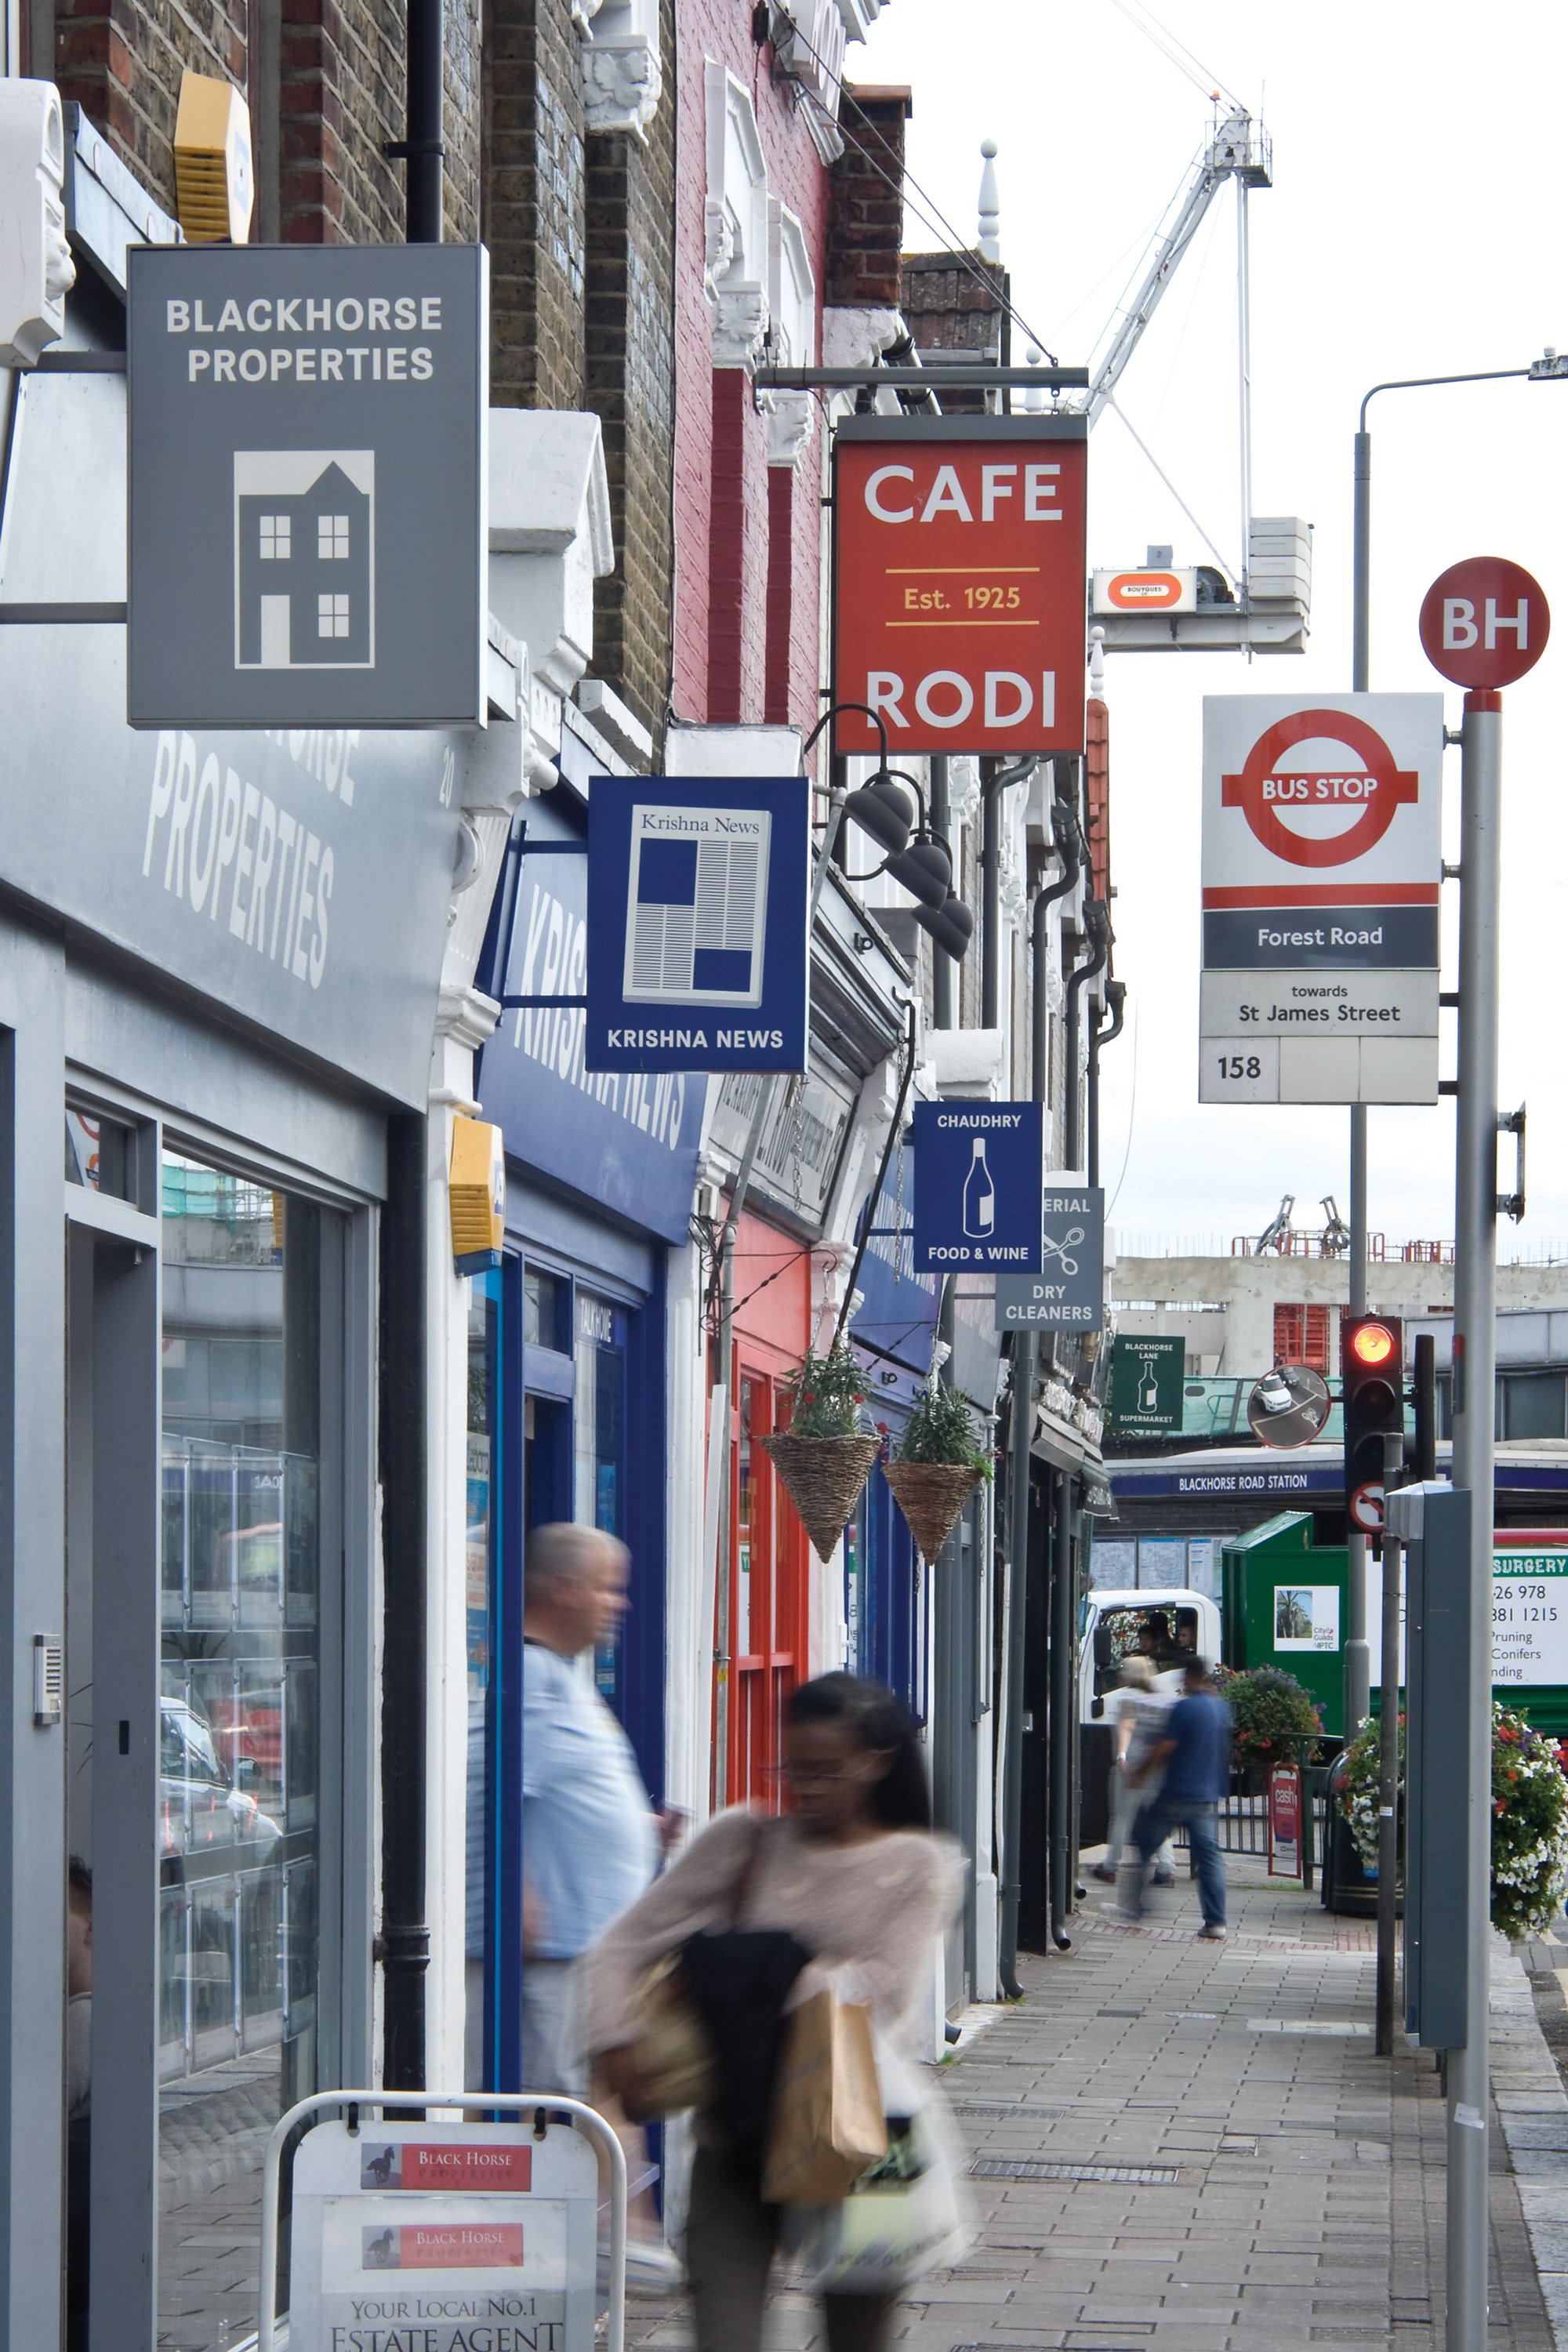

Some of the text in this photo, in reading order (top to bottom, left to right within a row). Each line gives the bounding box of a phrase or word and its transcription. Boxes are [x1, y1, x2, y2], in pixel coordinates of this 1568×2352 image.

[166, 297, 442, 332] BLACKHORSE
[188, 347, 434, 382] PROPERTIES
[864, 463, 1063, 524] CAFE
[904, 586, 1021, 610] Est. 1925
[1443, 597, 1528, 651] BH
[866, 670, 1056, 729] RODI
[1262, 778, 1378, 800] BUS STOP
[641, 814, 760, 834] Krishna News
[143, 730, 334, 989] PROPERTIES
[1258, 926, 1383, 947] Forest Road
[1291, 985, 1348, 998] towards
[1239, 1004, 1400, 1022] St James Street
[608, 1029, 784, 1049] KRISHNA NEWS
[1218, 1056, 1261, 1080] 158
[937, 1115, 1022, 1128] CHAUDHRY
[1044, 1199, 1091, 1213] ERIAL
[927, 1247, 1029, 1260] FOOD & WINE
[1033, 1285, 1066, 1299] DRY
[1005, 1305, 1093, 1320] CLEANERS
[1124, 1343, 1174, 1352] BLACKHORSE
[1119, 1414, 1174, 1424] SUPERMARKET
[1179, 1474, 1308, 1491] BLACKHORSE ROAD STATION
[1493, 1559, 1566, 1573] SURGERY
[1493, 1585, 1545, 1599] 26 978
[1524, 1607, 1558, 1621] 1215
[1492, 1647, 1541, 1660] Conifers
[1491, 1666, 1523, 1679] nding
[1276, 1786, 1294, 1804] cash
[419, 2151, 512, 2166] BLACK HORSE
[416, 2230, 504, 2245] BLACK HORSE
[350, 2300, 410, 2320] YOUR
[416, 2299, 483, 2318] LOCAL
[329, 2322, 564, 2352] ESTATE AGENT
